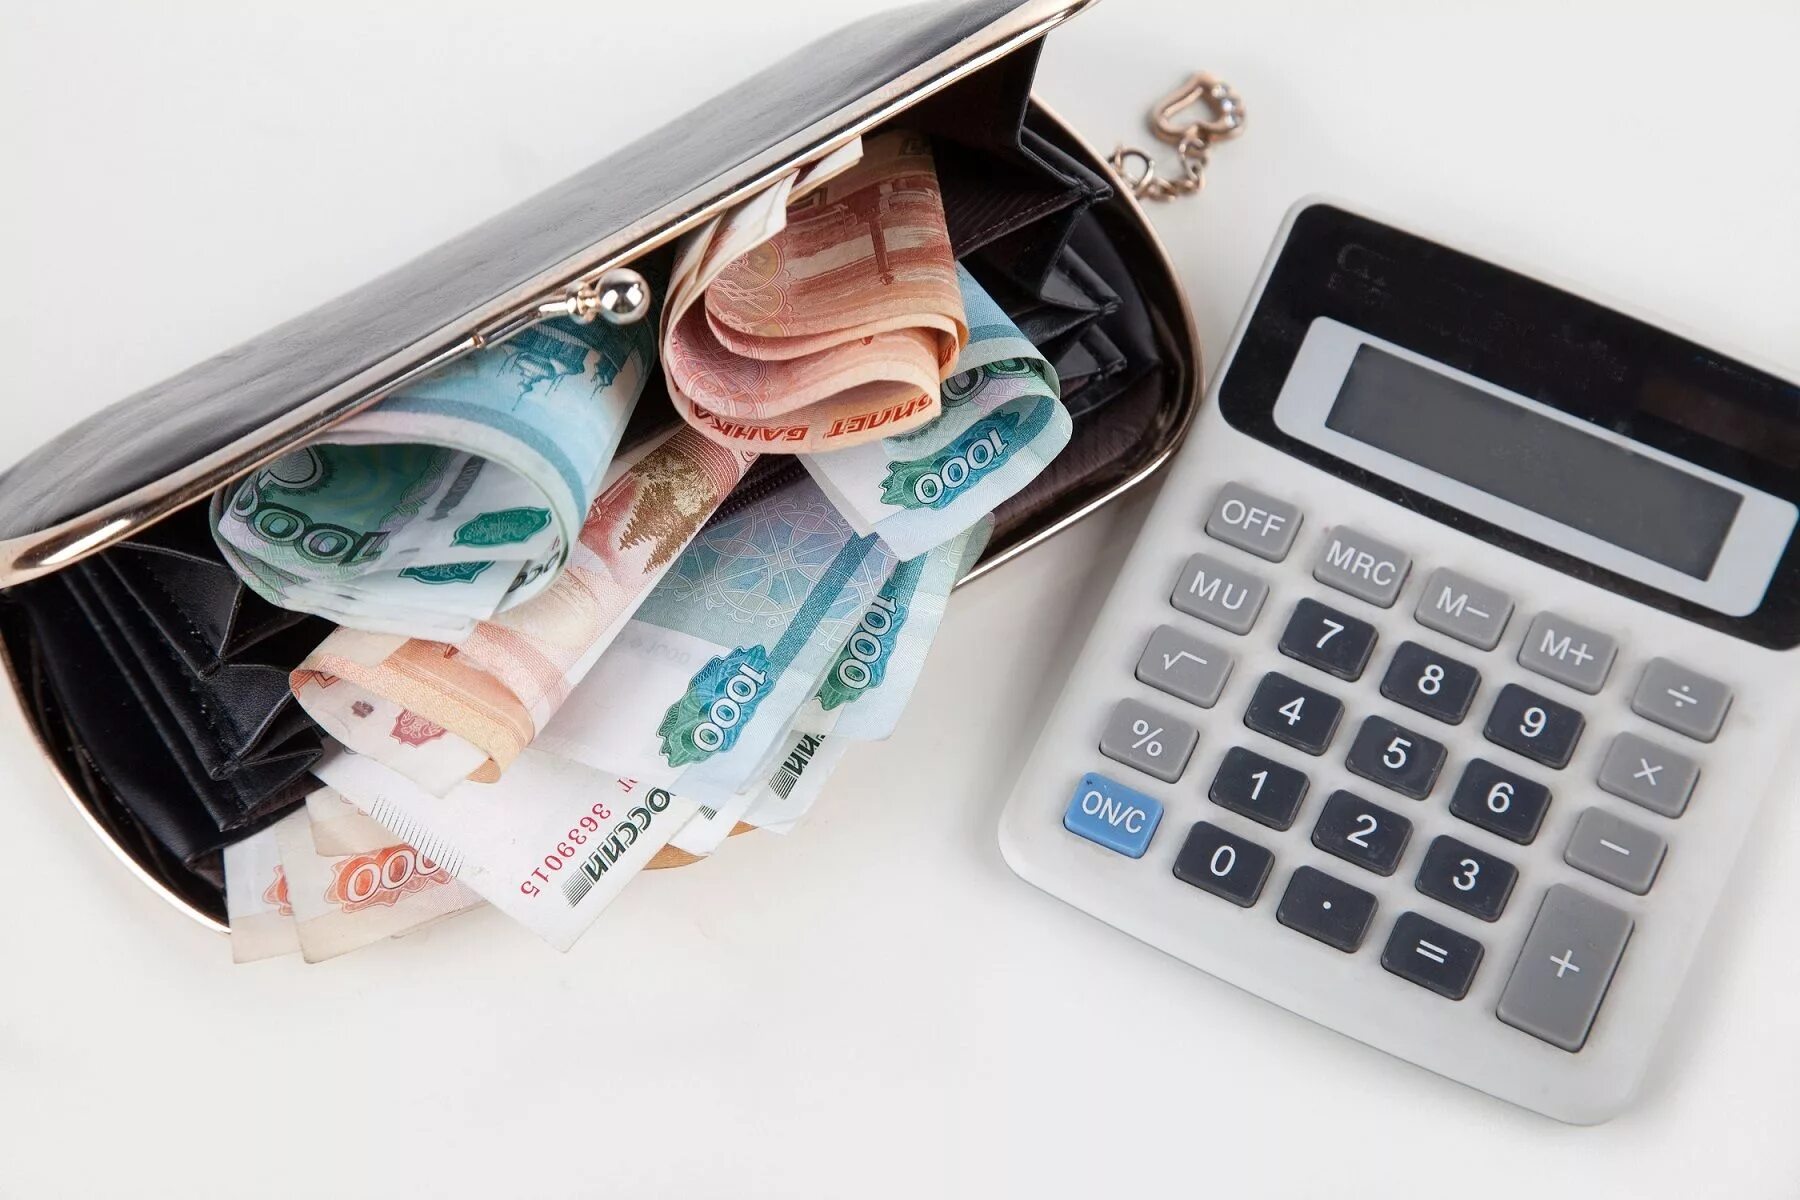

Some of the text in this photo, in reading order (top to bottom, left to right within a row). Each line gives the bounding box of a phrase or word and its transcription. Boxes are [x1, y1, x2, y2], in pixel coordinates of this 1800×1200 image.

[914, 428, 1009, 504] 1000
[1221, 499, 1285, 537] OFF
[1326, 540, 1396, 586] MRC
[1190, 571, 1248, 610] MU
[838, 595, 898, 689] 1000
[1315, 618, 1344, 649] 7
[1540, 630, 1594, 666] M+
[1418, 664, 1445, 695] 8
[693, 663, 767, 752] 1000
[1278, 696, 1304, 725] 4
[1519, 706, 1546, 738] 9
[1132, 719, 1163, 757] %
[1383, 736, 1412, 769] 5
[1250, 770, 1269, 800] 1
[1487, 781, 1515, 813] 6
[1081, 790, 1146, 834] ON/C
[580, 786, 677, 886] ОССИИ
[1346, 814, 1378, 848] 2
[520, 803, 611, 897] 3639015
[1209, 845, 1236, 877] 0
[1452, 859, 1480, 891] 3
